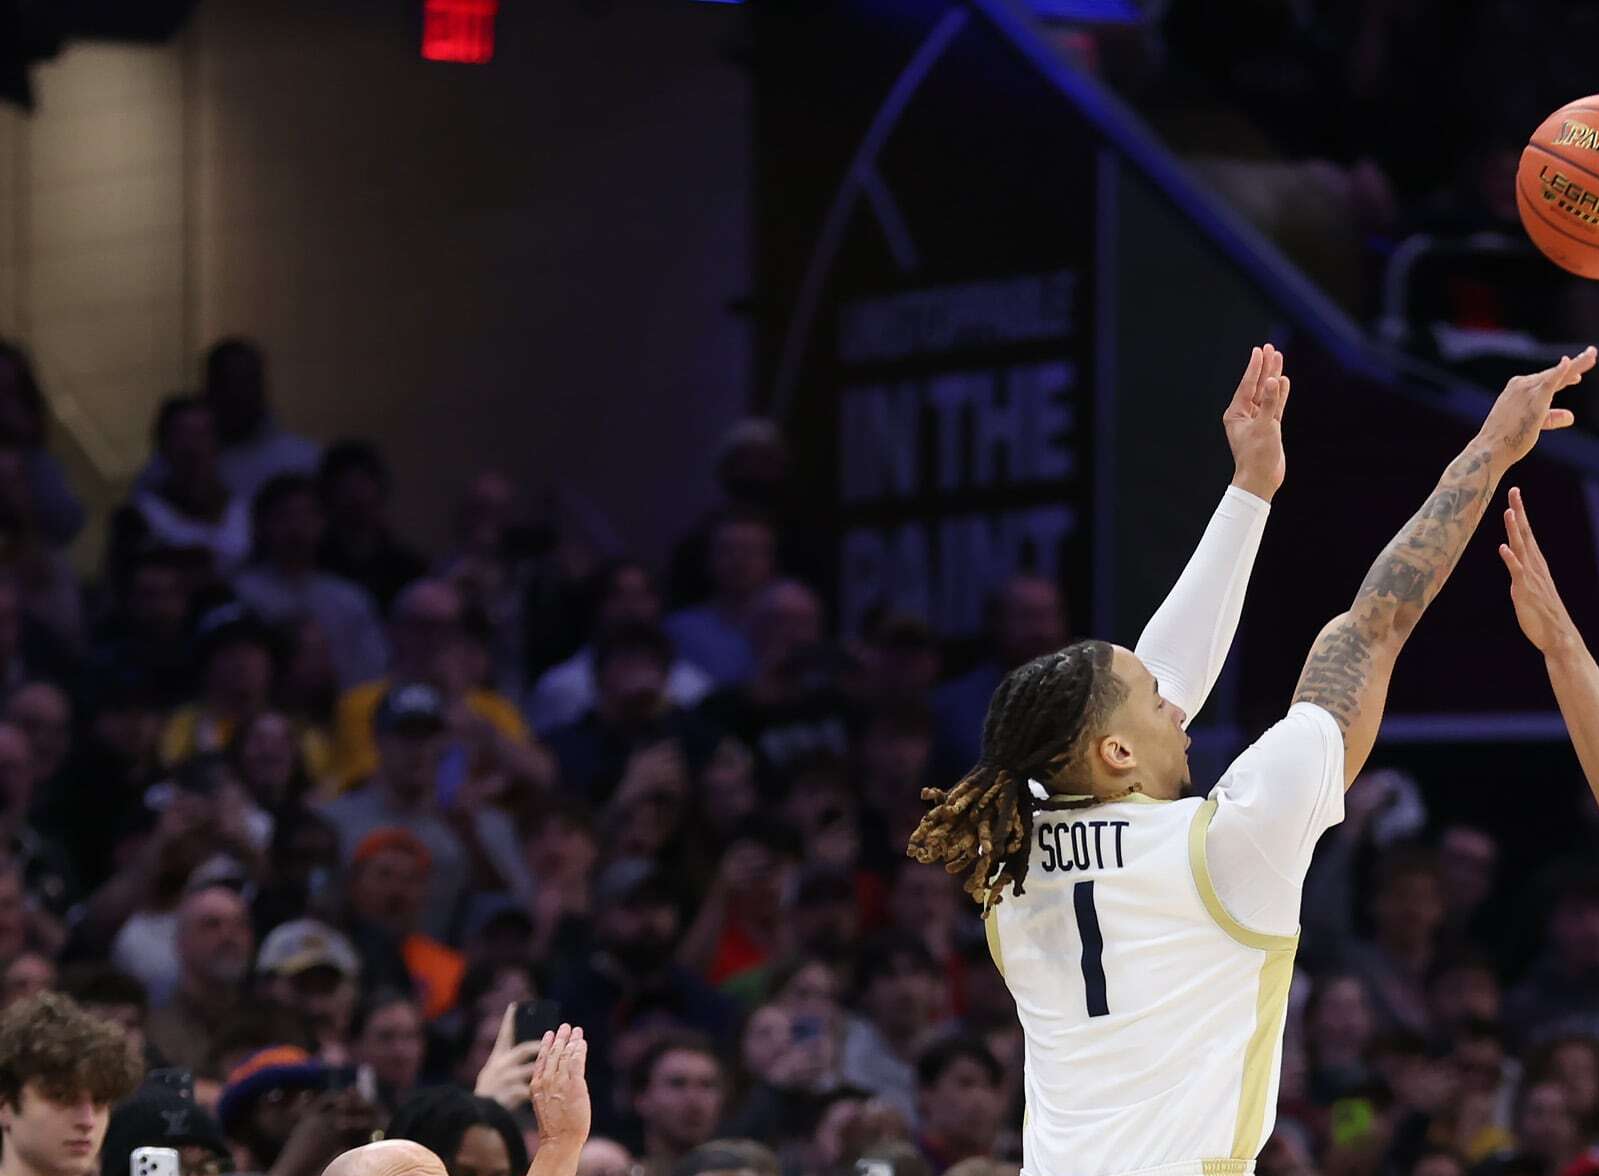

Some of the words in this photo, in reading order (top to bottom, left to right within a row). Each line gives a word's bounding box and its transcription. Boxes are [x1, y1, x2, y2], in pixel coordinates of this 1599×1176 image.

[929, 359, 1076, 492] THE
[1038, 820, 1130, 872] SCOTT
[1073, 880, 1111, 1018] 1
